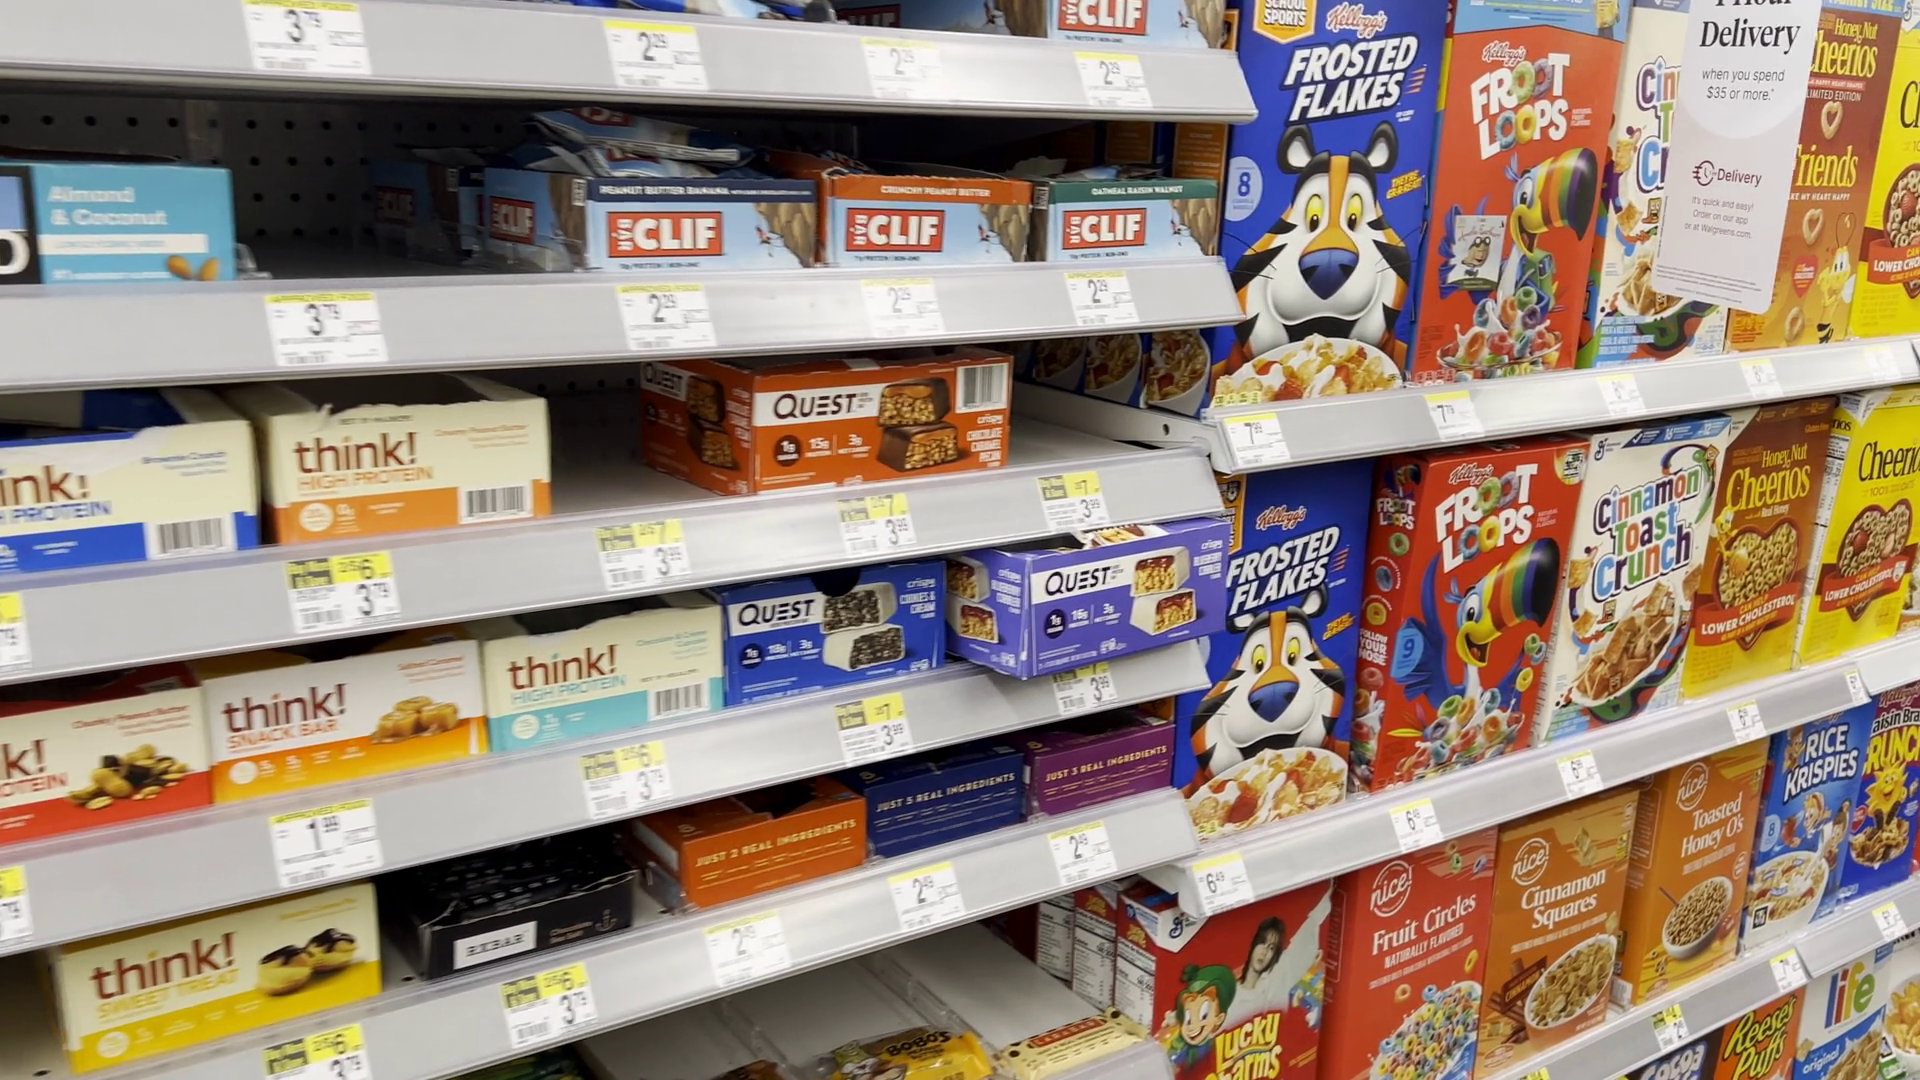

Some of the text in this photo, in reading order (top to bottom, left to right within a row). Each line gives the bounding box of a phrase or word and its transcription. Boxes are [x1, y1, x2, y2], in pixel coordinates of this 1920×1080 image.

[1076, 0, 1142, 28] CLIF
[1264, 9, 1307, 27] SPORTS
[1326, 3, 1387, 38] Kellogg's
[1835, 18, 1878, 42] Honey Nut
[1699, 18, 1800, 55] Delivery
[1284, 36, 1418, 86] FROSTED
[1482, 40, 1527, 67] Kellogg's
[1470, 53, 1571, 125] FROOT
[1702, 68, 1785, 84] when you spend
[1289, 72, 1405, 122] FLAKES
[1707, 85, 1741, 100] $35 or
[1806, 88, 1862, 102] LIMITED EDITION
[1478, 99, 1569, 160] LOOPS
[1091, 186, 1126, 196] OATMEAL
[1238, 171, 1251, 197] 8
[1717, 167, 1762, 187] Delivery
[47, 185, 135, 203] Almond
[1703, 197, 1719, 209] quick
[1721, 199, 1734, 209] and
[1736, 201, 1754, 213] easy!
[1812, 193, 1832, 201] HEART
[50, 208, 168, 226] & Coconut
[867, 214, 939, 246] CLIF
[1081, 214, 1141, 243] CLIF
[1684, 222, 1692, 230] or
[1693, 209, 1749, 226] Order on our app
[632, 217, 716, 251] CLIF
[1874, 259, 1902, 273] LOWER
[773, 393, 857, 420] QUEST
[293, 431, 420, 474] think!
[1762, 443, 1808, 469] Honey Nut
[0, 463, 91, 508] ink!
[350, 466, 434, 486] PROTEIN
[1449, 462, 1494, 485] Kellogg's
[1725, 464, 1811, 513] Cheerios
[1376, 498, 1416, 515] FROOT
[1435, 463, 1538, 543] FROOT
[1597, 466, 1700, 531] Cinnamon
[1256, 504, 1308, 530] Kellogg's
[1379, 511, 1415, 530] LOOPS
[1615, 501, 1678, 557] Toast
[1442, 505, 1535, 574] LOOPS
[1226, 526, 1340, 589] FROSTED
[1597, 522, 1693, 599] Crunch
[1045, 565, 1111, 595] QUEST
[1229, 556, 1328, 617] FLAKES
[1825, 588, 1850, 602] LOWER
[1850, 568, 1892, 596] CHOLESTEROL
[738, 599, 815, 627] QUEST
[1103, 603, 1115, 615] 3g
[1701, 618, 1738, 636] LOWER
[1739, 593, 1796, 626] CHOLESTEROL
[1359, 627, 1389, 644] FOLLOW
[1360, 638, 1388, 655] YOUR
[1402, 638, 1415, 659] 9
[507, 643, 618, 691] think!
[1358, 649, 1387, 667] NOSE
[511, 686, 556, 706] HIGH
[559, 674, 627, 696] PROTEIN
[221, 681, 349, 734] think!
[1872, 709, 1920, 735] aisin Bra
[227, 718, 339, 750] SNACK BAR
[1804, 723, 1849, 763] RICE
[1045, 745, 1168, 783] JUST REAL INGREDIENTS
[1783, 749, 1860, 803] KRISPIES
[876, 772, 1016, 813] JUST REAL INGREDIENTS
[1676, 770, 1708, 806] nice!
[1692, 791, 1743, 833] Toasted
[695, 851, 727, 868] JUST
[742, 840, 774, 855] REAL
[776, 818, 857, 847] INGREDIENTS
[1681, 827, 1723, 859] Honey
[1726, 813, 1745, 839] O's
[1767, 821, 1776, 838] 8
[1511, 842, 1550, 881] nice!
[1370, 864, 1414, 911] nice!
[1521, 868, 1606, 911] Cinnamon
[1372, 920, 1420, 956] Fruit
[1422, 893, 1477, 934] Circles
[1531, 892, 1598, 930] Squares
[1384, 940, 1428, 969] NATURALLY
[1428, 923, 1464, 950] FLAVORED
[89, 931, 238, 1000] think!
[178, 968, 240, 996] TREAT
[1825, 962, 1875, 1030] life
[885, 1030, 951, 1057] BOBO'S
[1802, 1044, 1840, 1075] original
